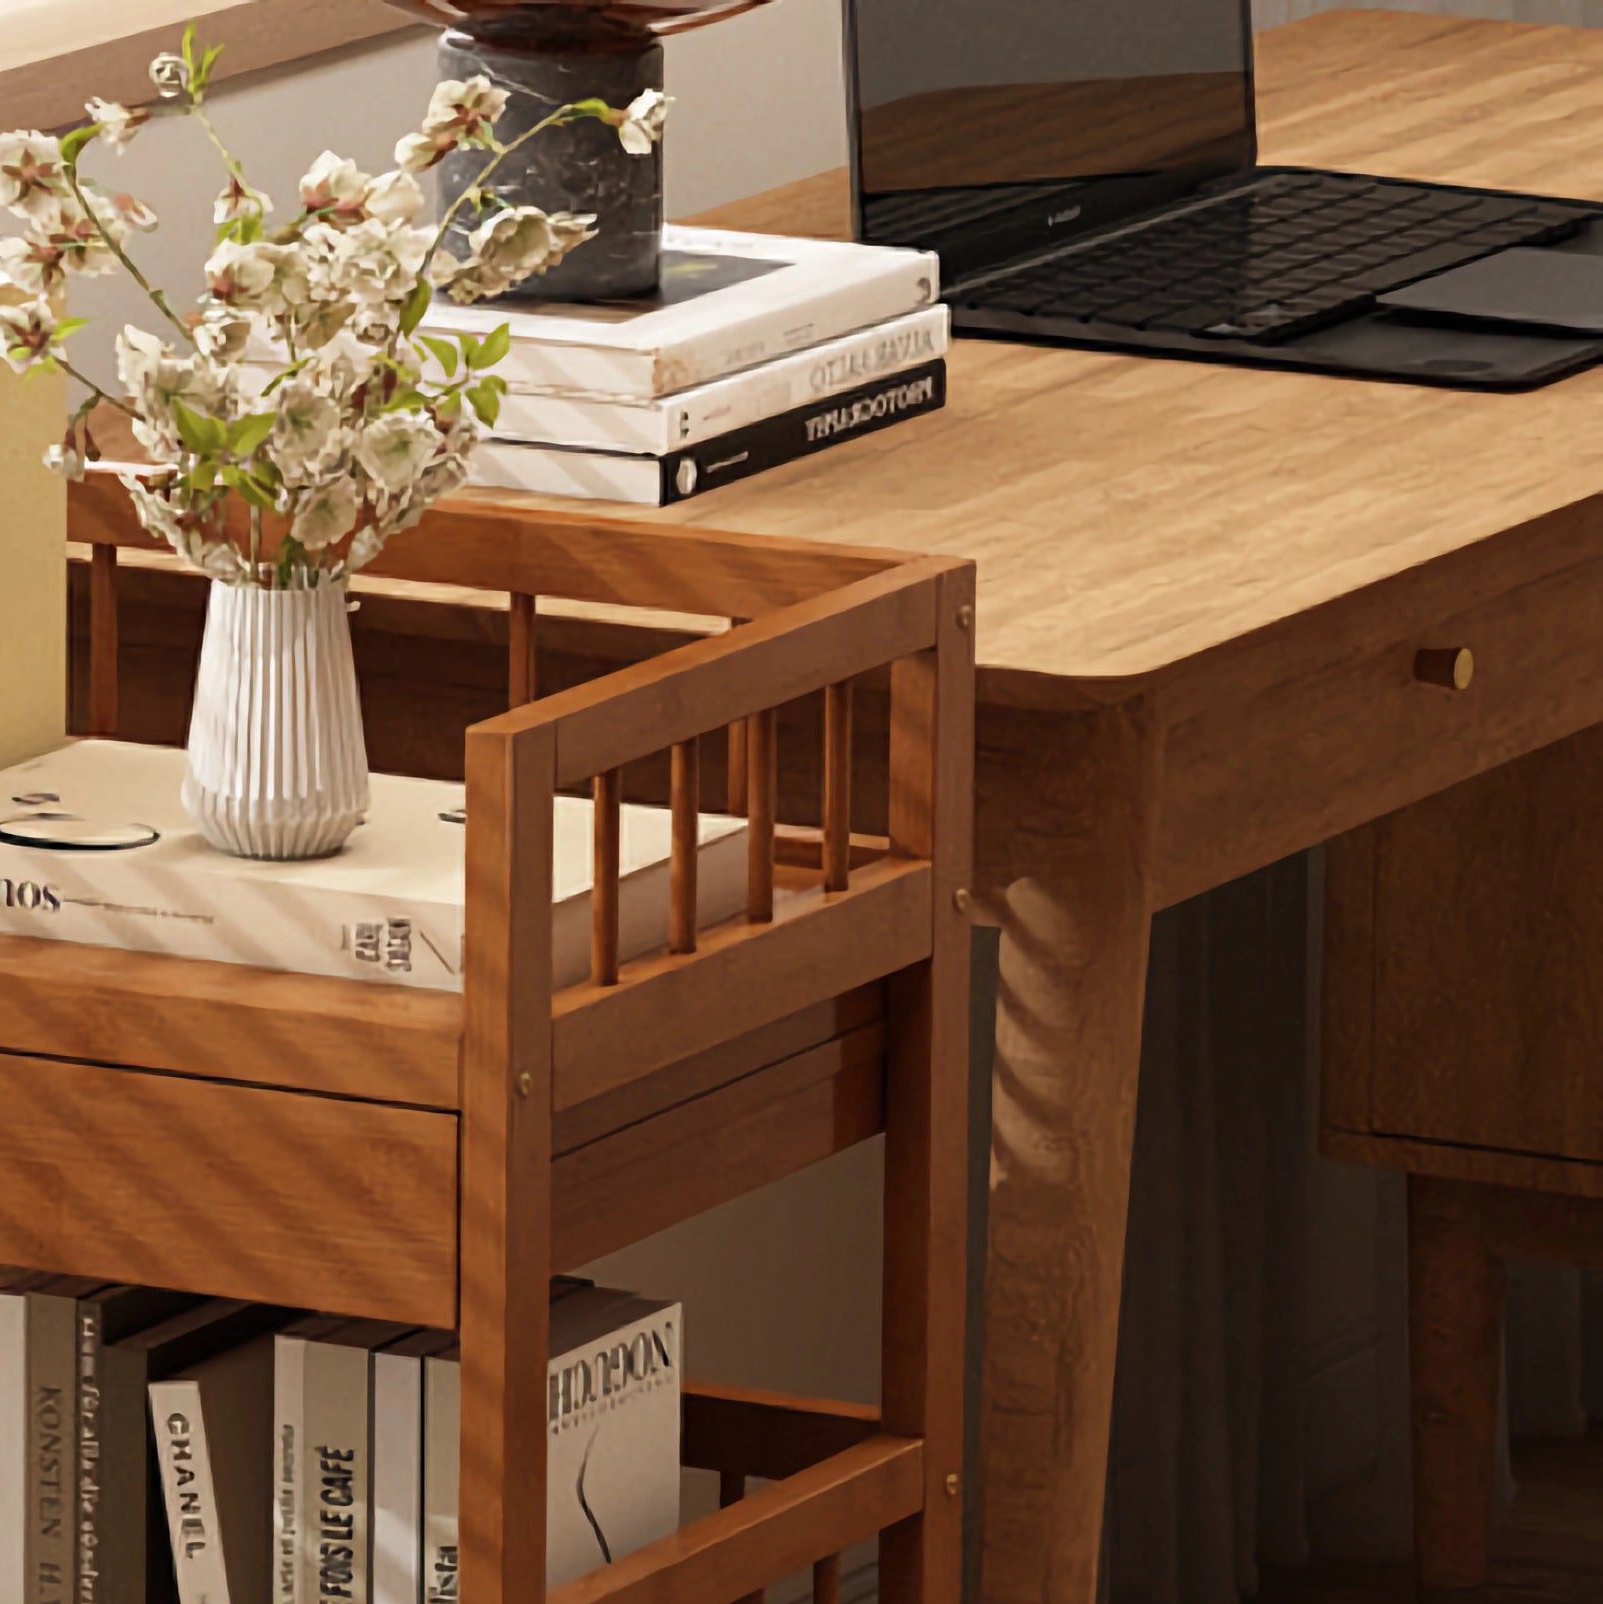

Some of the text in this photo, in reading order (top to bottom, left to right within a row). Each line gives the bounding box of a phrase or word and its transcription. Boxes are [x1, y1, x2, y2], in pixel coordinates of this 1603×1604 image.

[36, 1385, 64, 1539] KONSTEN
[166, 1410, 204, 1561] CHANEL
[312, 1444, 356, 1507] CAFÉ
[318, 1508, 355, 1541] LE
